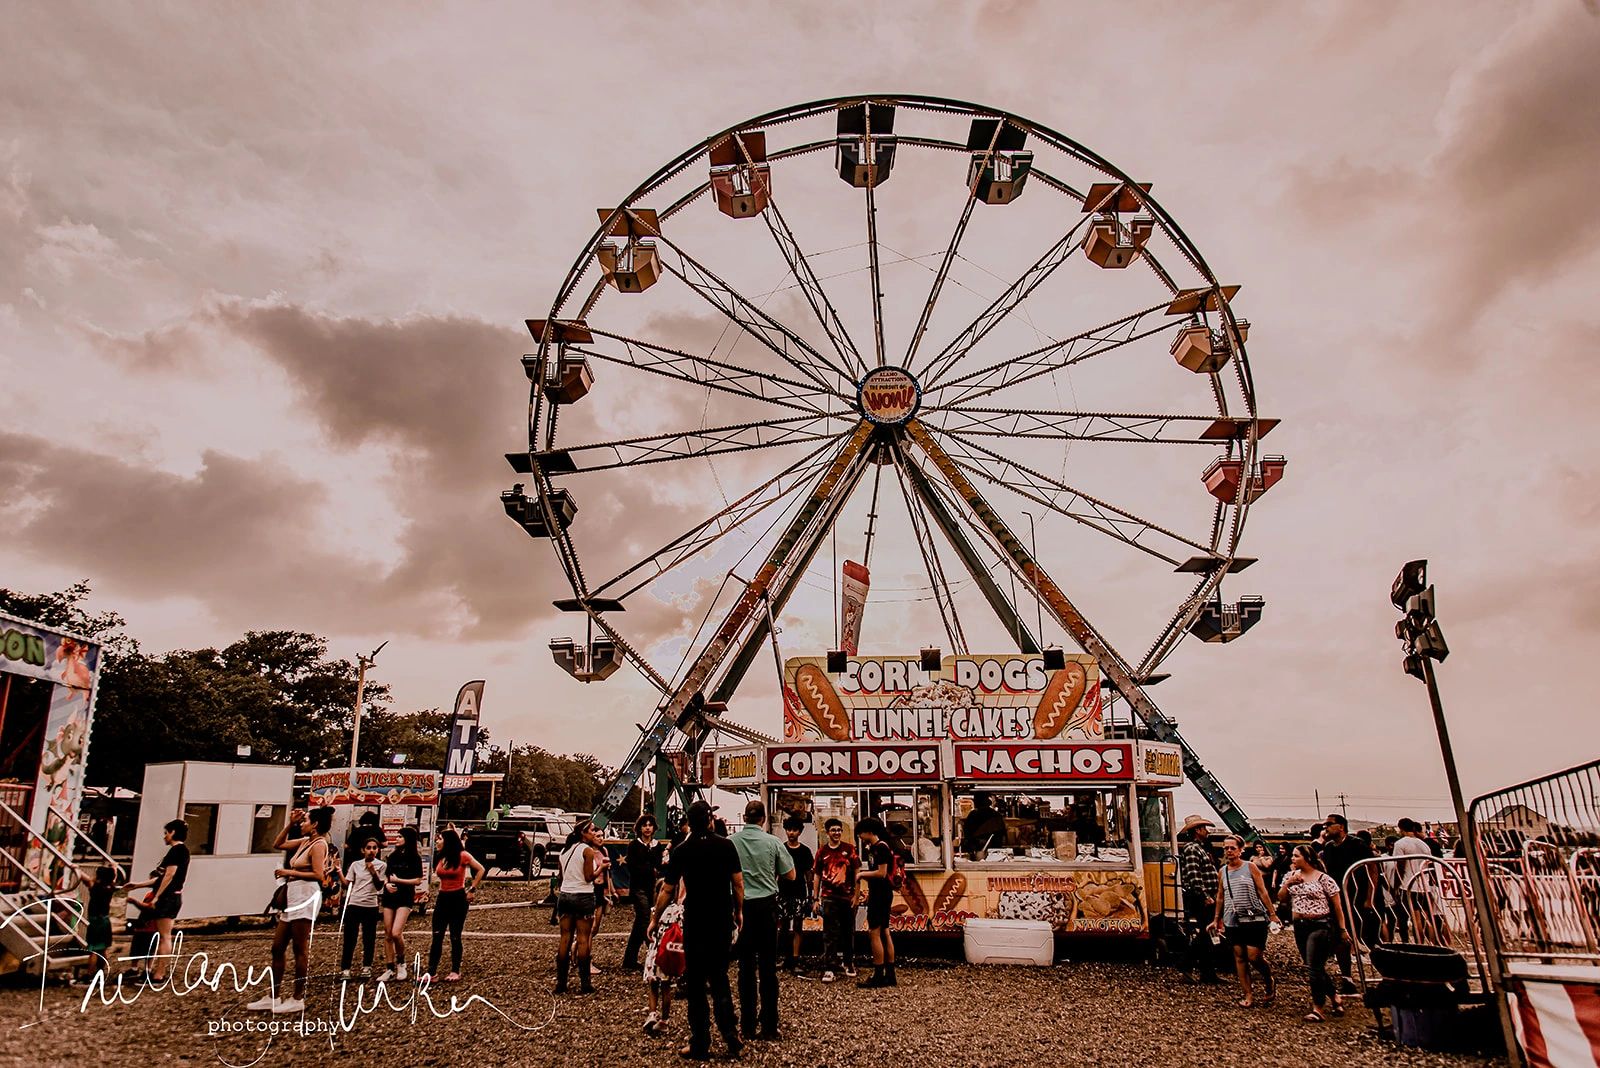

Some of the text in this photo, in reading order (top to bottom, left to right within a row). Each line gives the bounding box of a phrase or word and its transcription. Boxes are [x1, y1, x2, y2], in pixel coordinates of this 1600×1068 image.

[0, 628, 46, 666] ON
[838, 658, 1048, 693] CORN DOGS
[448, 690, 478, 774] ATM
[853, 706, 1032, 739] FUNNEL CAKES
[771, 750, 937, 776] CORN DOGS
[961, 749, 1124, 775] NACHOS
[356, 771, 435, 790] TICKETS
[988, 877, 1033, 892] FUNNEL
[1440, 879, 1473, 898] PUS
[1073, 919, 1142, 933] NACHOS
